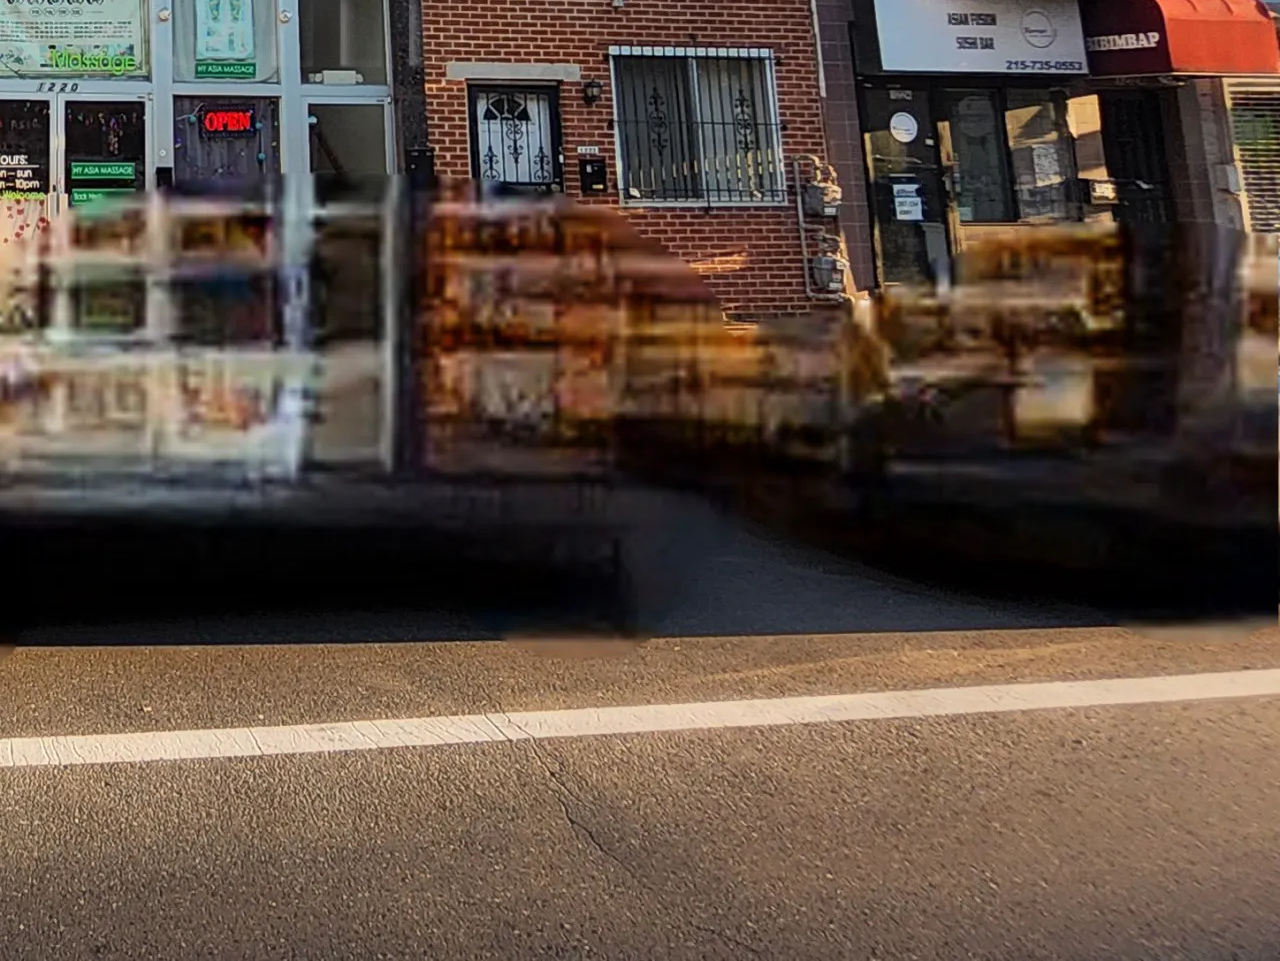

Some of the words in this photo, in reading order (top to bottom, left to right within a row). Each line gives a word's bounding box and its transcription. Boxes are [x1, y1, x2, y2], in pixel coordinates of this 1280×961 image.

[223, 64, 254, 75] MASSAGE
[204, 110, 252, 132] OPEN
[100, 166, 132, 175] MASSAGE
